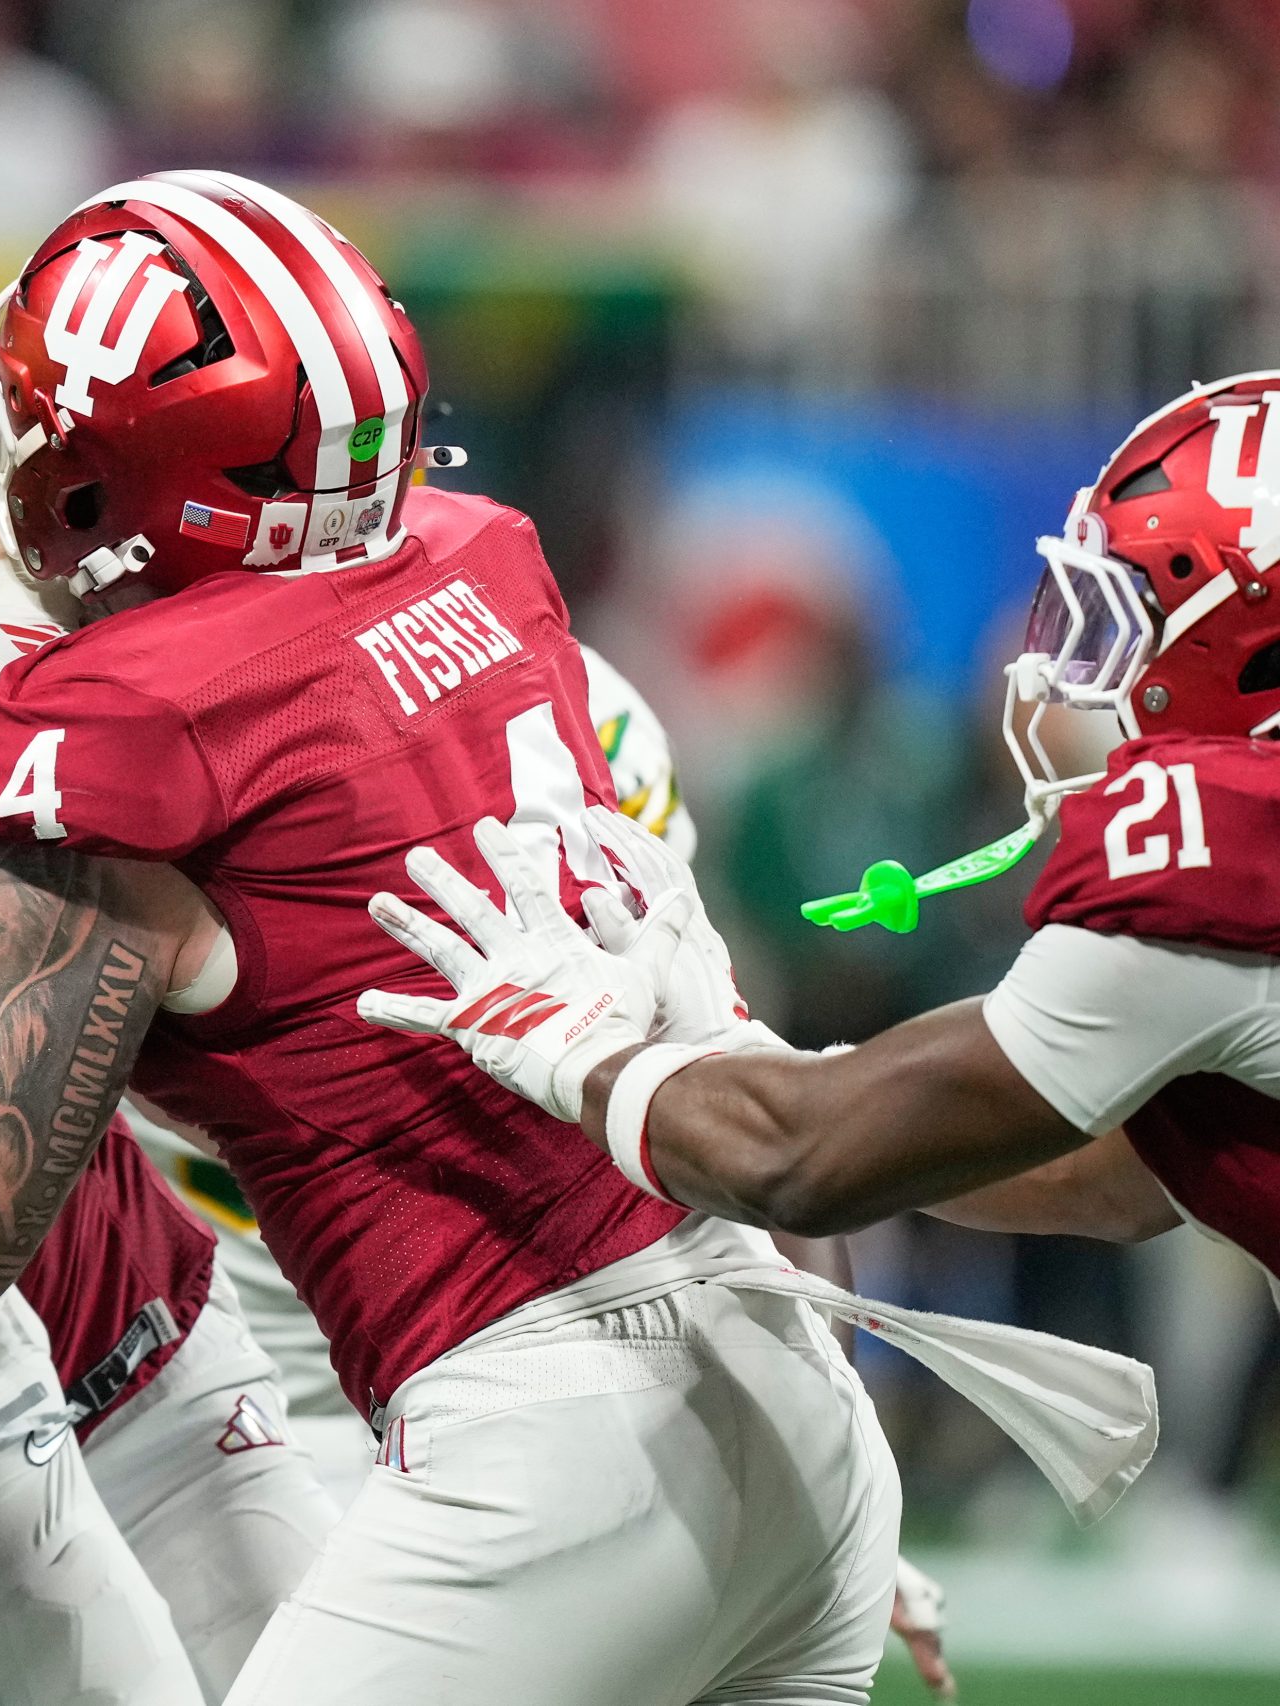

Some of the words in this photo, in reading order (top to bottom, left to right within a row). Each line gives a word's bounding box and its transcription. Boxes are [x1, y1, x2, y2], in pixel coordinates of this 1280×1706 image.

[352, 427, 383, 448] C2P
[319, 537, 340, 548] CFP
[354, 579, 523, 717] FISHER
[1103, 761, 1212, 880] 21
[565, 993, 614, 1045] ADIZERO
